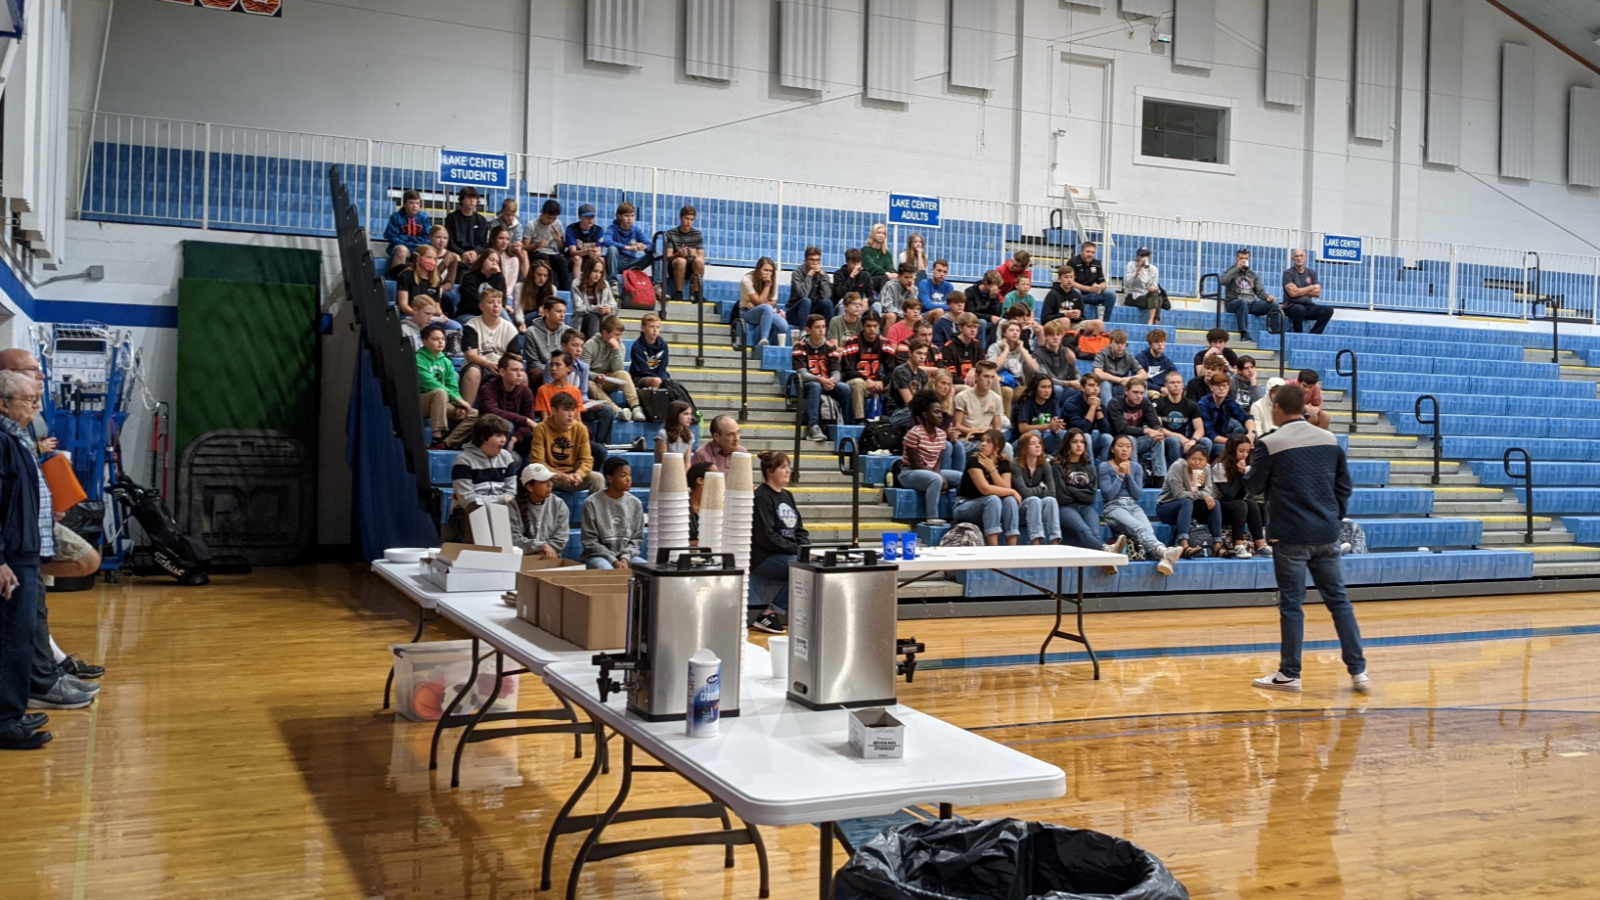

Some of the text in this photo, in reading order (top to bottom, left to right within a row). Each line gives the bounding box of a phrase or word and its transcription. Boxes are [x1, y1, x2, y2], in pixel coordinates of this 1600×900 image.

[443, 154, 505, 170] LAKE CENTER
[450, 168, 498, 182] STUDENTS
[891, 198, 938, 211] LAKE CENTER
[901, 210, 929, 222] ADULTS
[1324, 238, 1361, 249] LAKE CENTER
[1328, 248, 1358, 258] RESERVED
